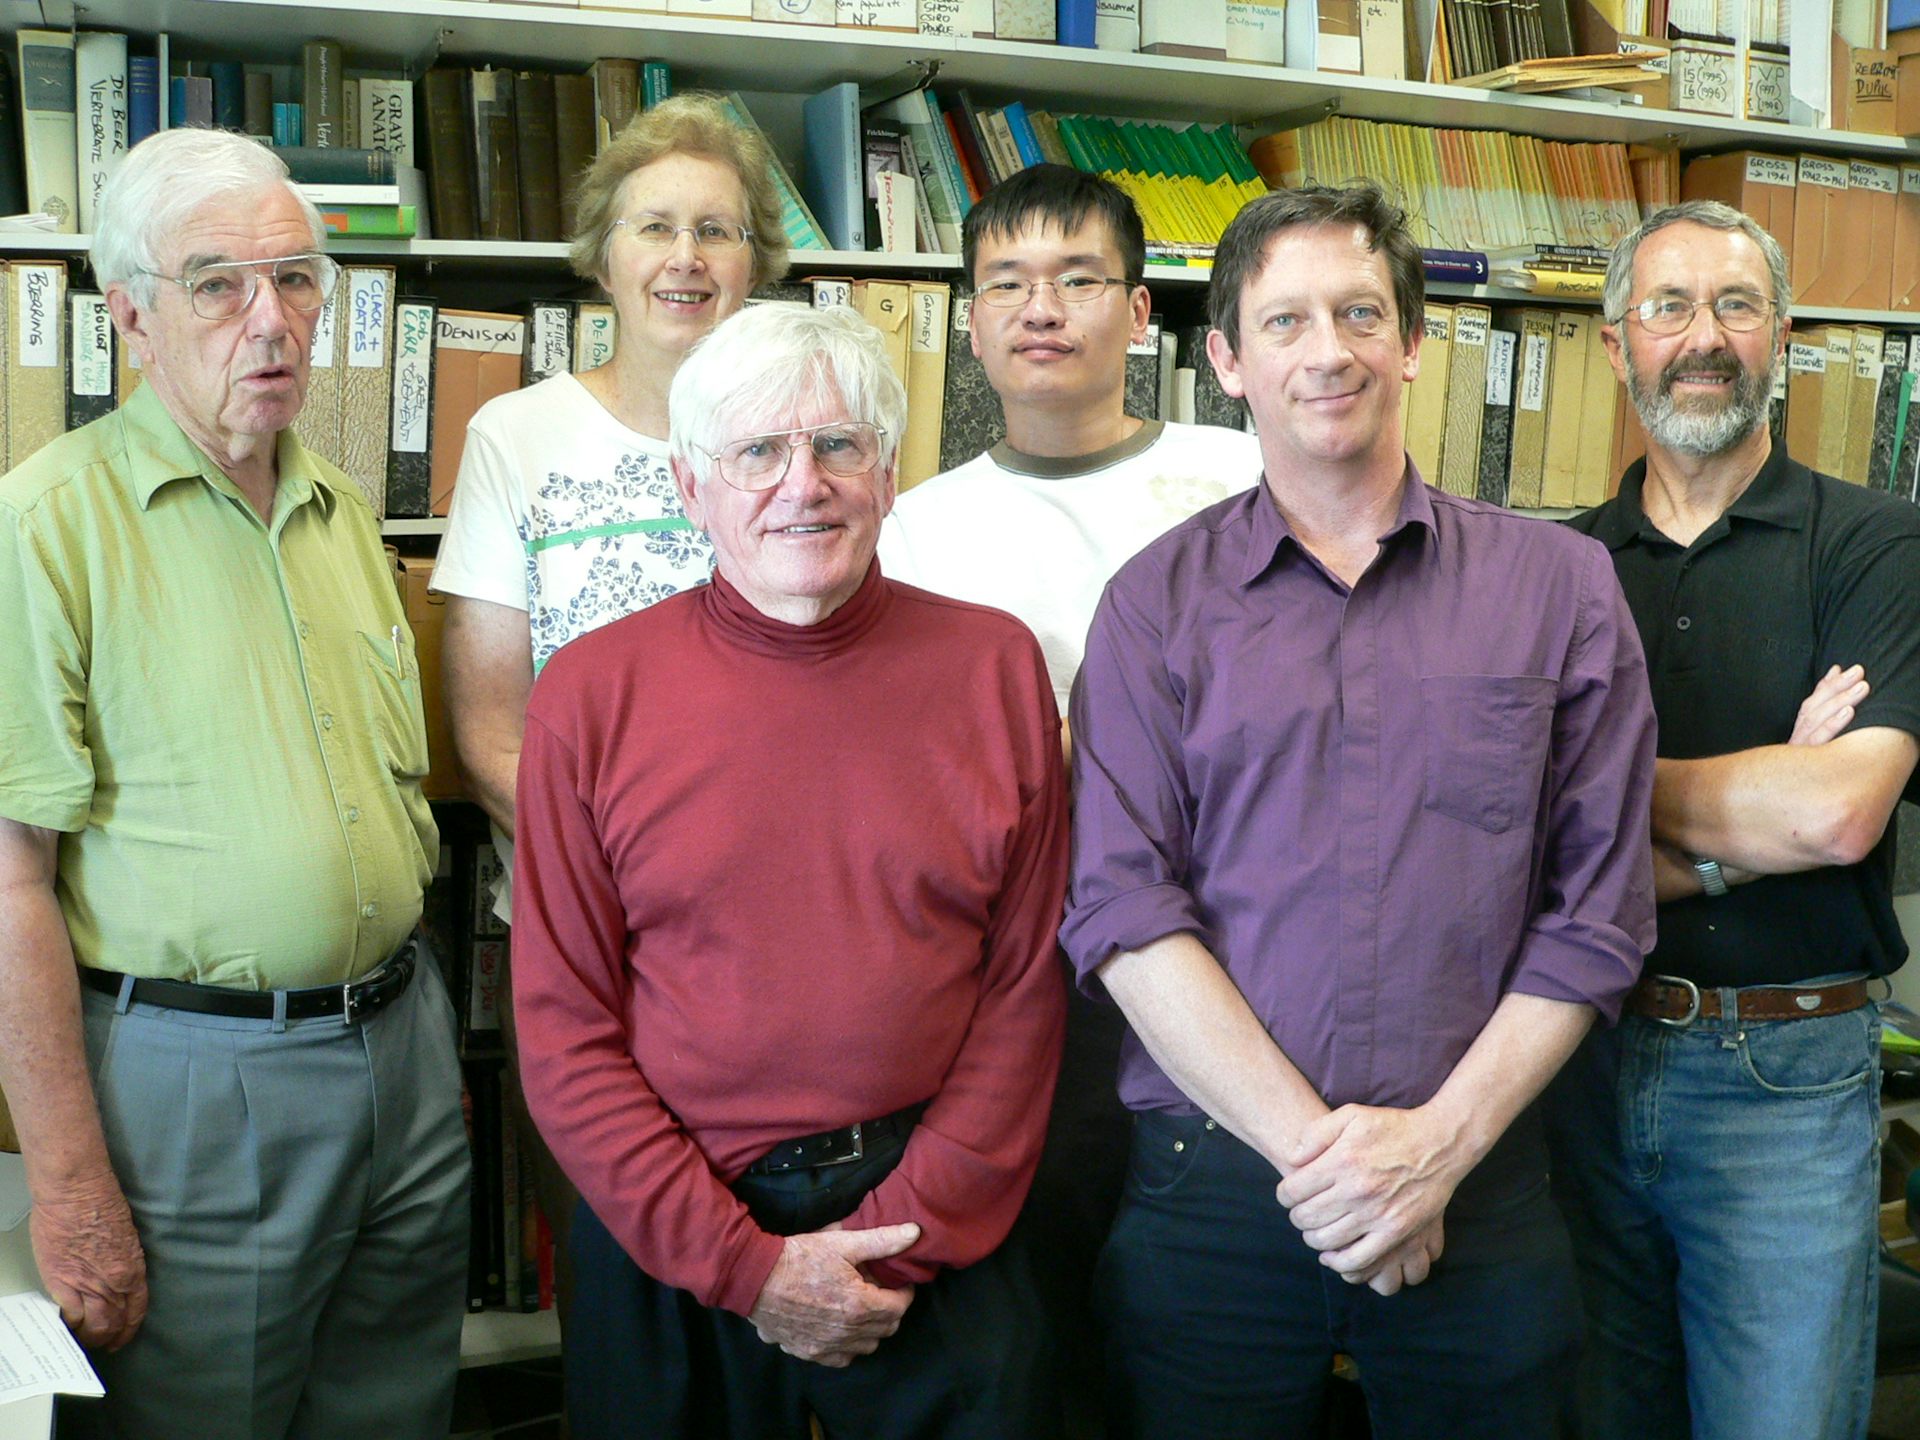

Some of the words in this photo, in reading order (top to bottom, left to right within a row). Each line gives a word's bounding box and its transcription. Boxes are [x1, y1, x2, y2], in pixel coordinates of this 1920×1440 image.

[920, 14, 950, 23] CSIRO
[1684, 68, 1695, 81] 15
[1697, 67, 1728, 85] (1995)
[110, 75, 124, 99] DE
[1683, 84, 1695, 96] 16
[90, 80, 106, 164] VERTEBRATE
[111, 106, 125, 154] BEER
[389, 94, 406, 154] GRAY'S
[1750, 157, 1788, 170] GROSS
[1801, 158, 1835, 172] GROSS
[1850, 162, 1878, 176] GROSS
[93, 172, 107, 207] SKUL
[27, 272, 49, 346] BJERRING
[371, 280, 384, 329] CLACK
[880, 299, 894, 313] G
[355, 289, 369, 352] COATES
[592, 317, 608, 338] DE
[917, 294, 935, 349] GAFFNEY
[1525, 319, 1552, 332] JESSEN
[400, 310, 418, 359] CARR
[436, 321, 516, 342] DENISON
[553, 324, 566, 358] Elliott
[369, 337, 380, 352] +
[1856, 339, 1875, 354] LONG
